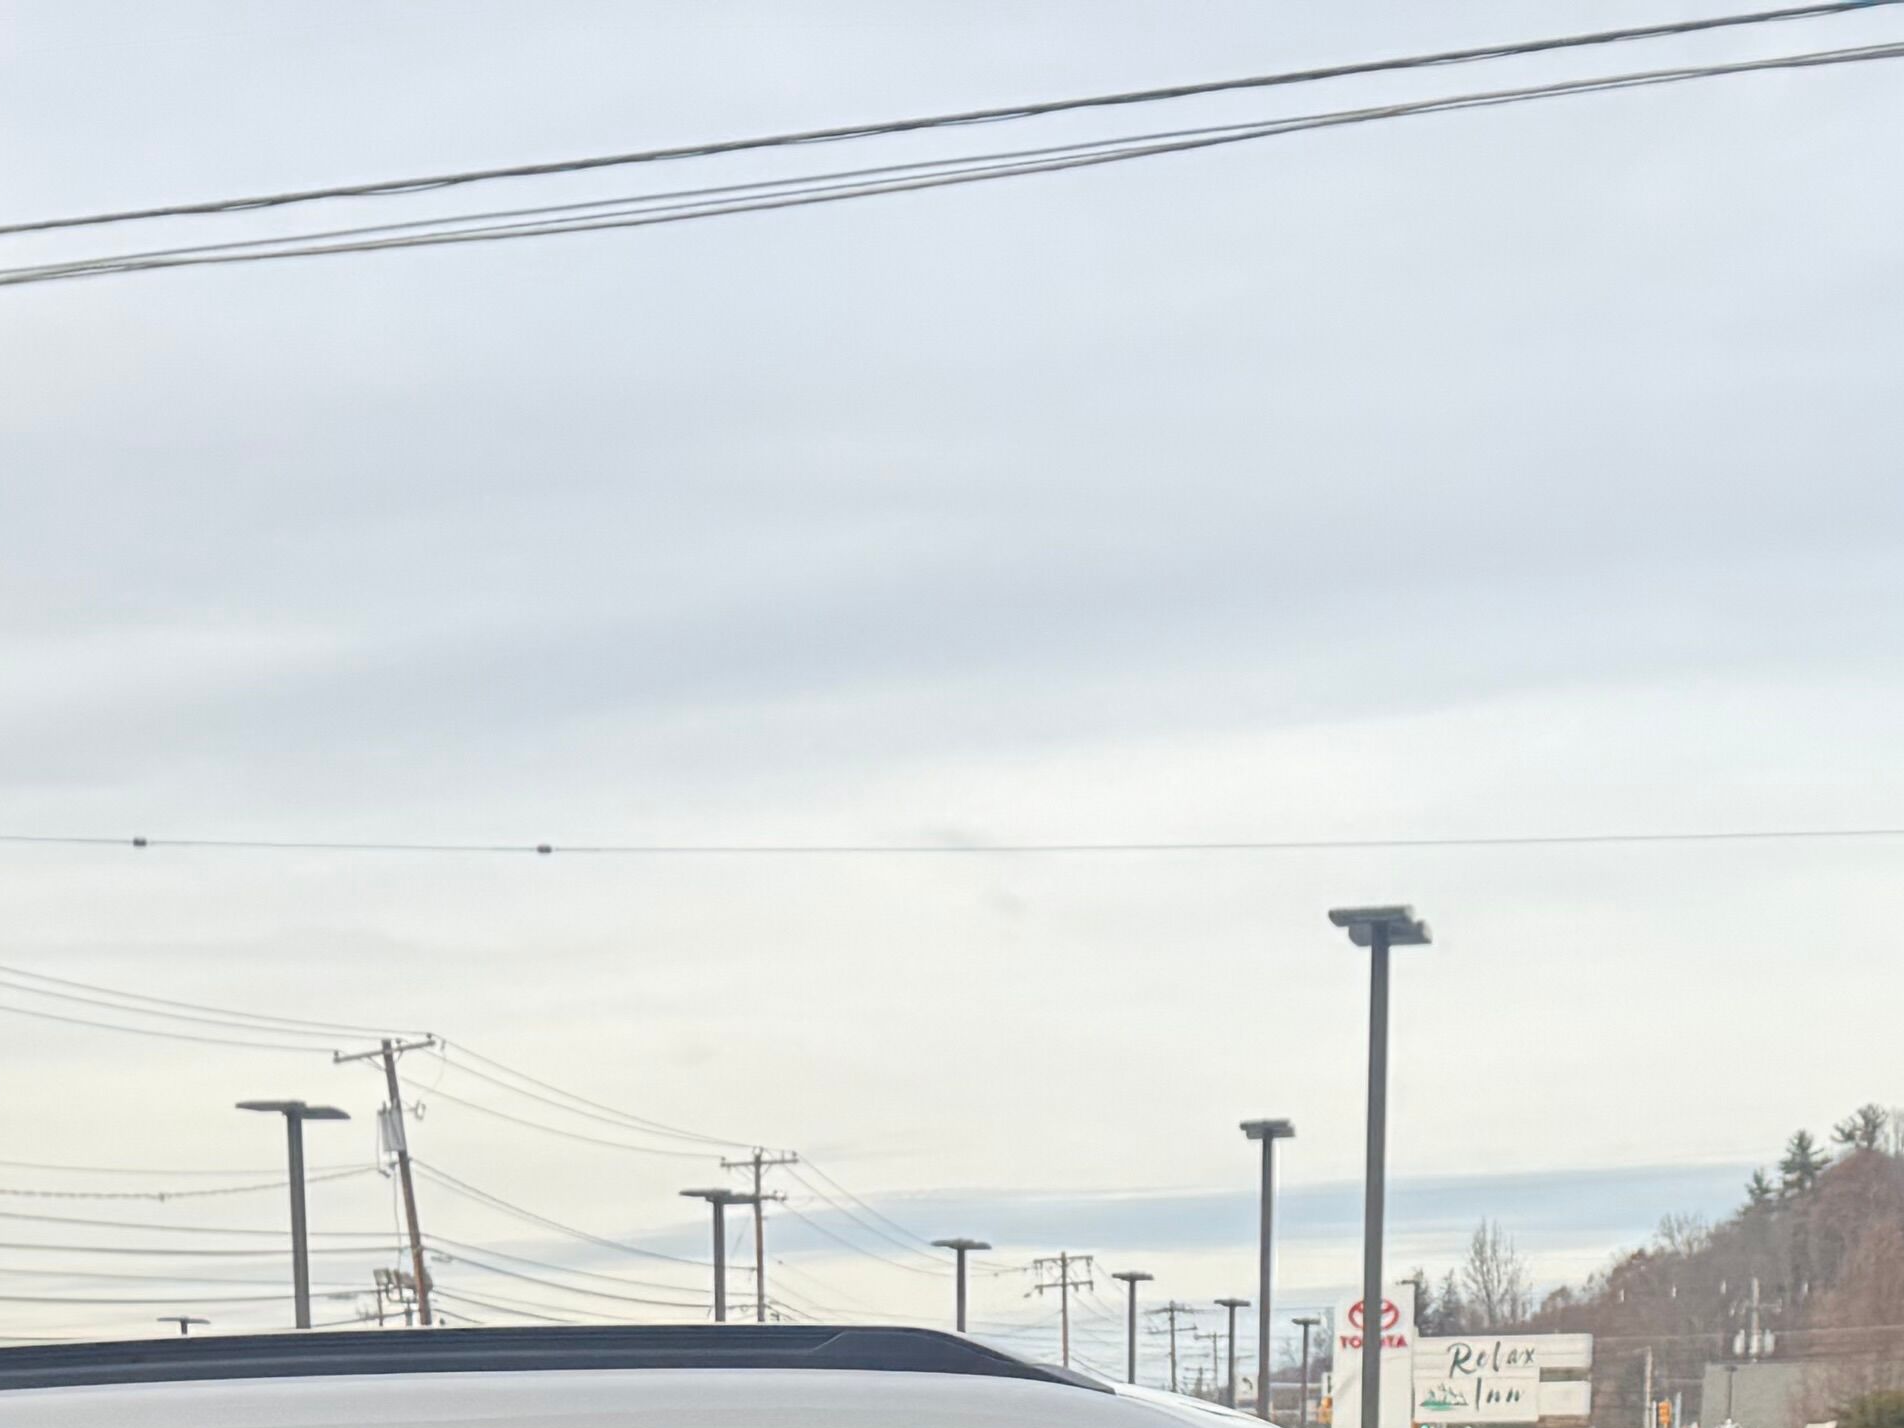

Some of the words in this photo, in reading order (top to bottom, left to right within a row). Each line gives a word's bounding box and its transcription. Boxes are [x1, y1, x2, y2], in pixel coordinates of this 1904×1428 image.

[1339, 1335, 1408, 1349] TOTA
[1446, 1340, 1535, 1379] Relax
[1475, 1376, 1520, 1412] Inn
